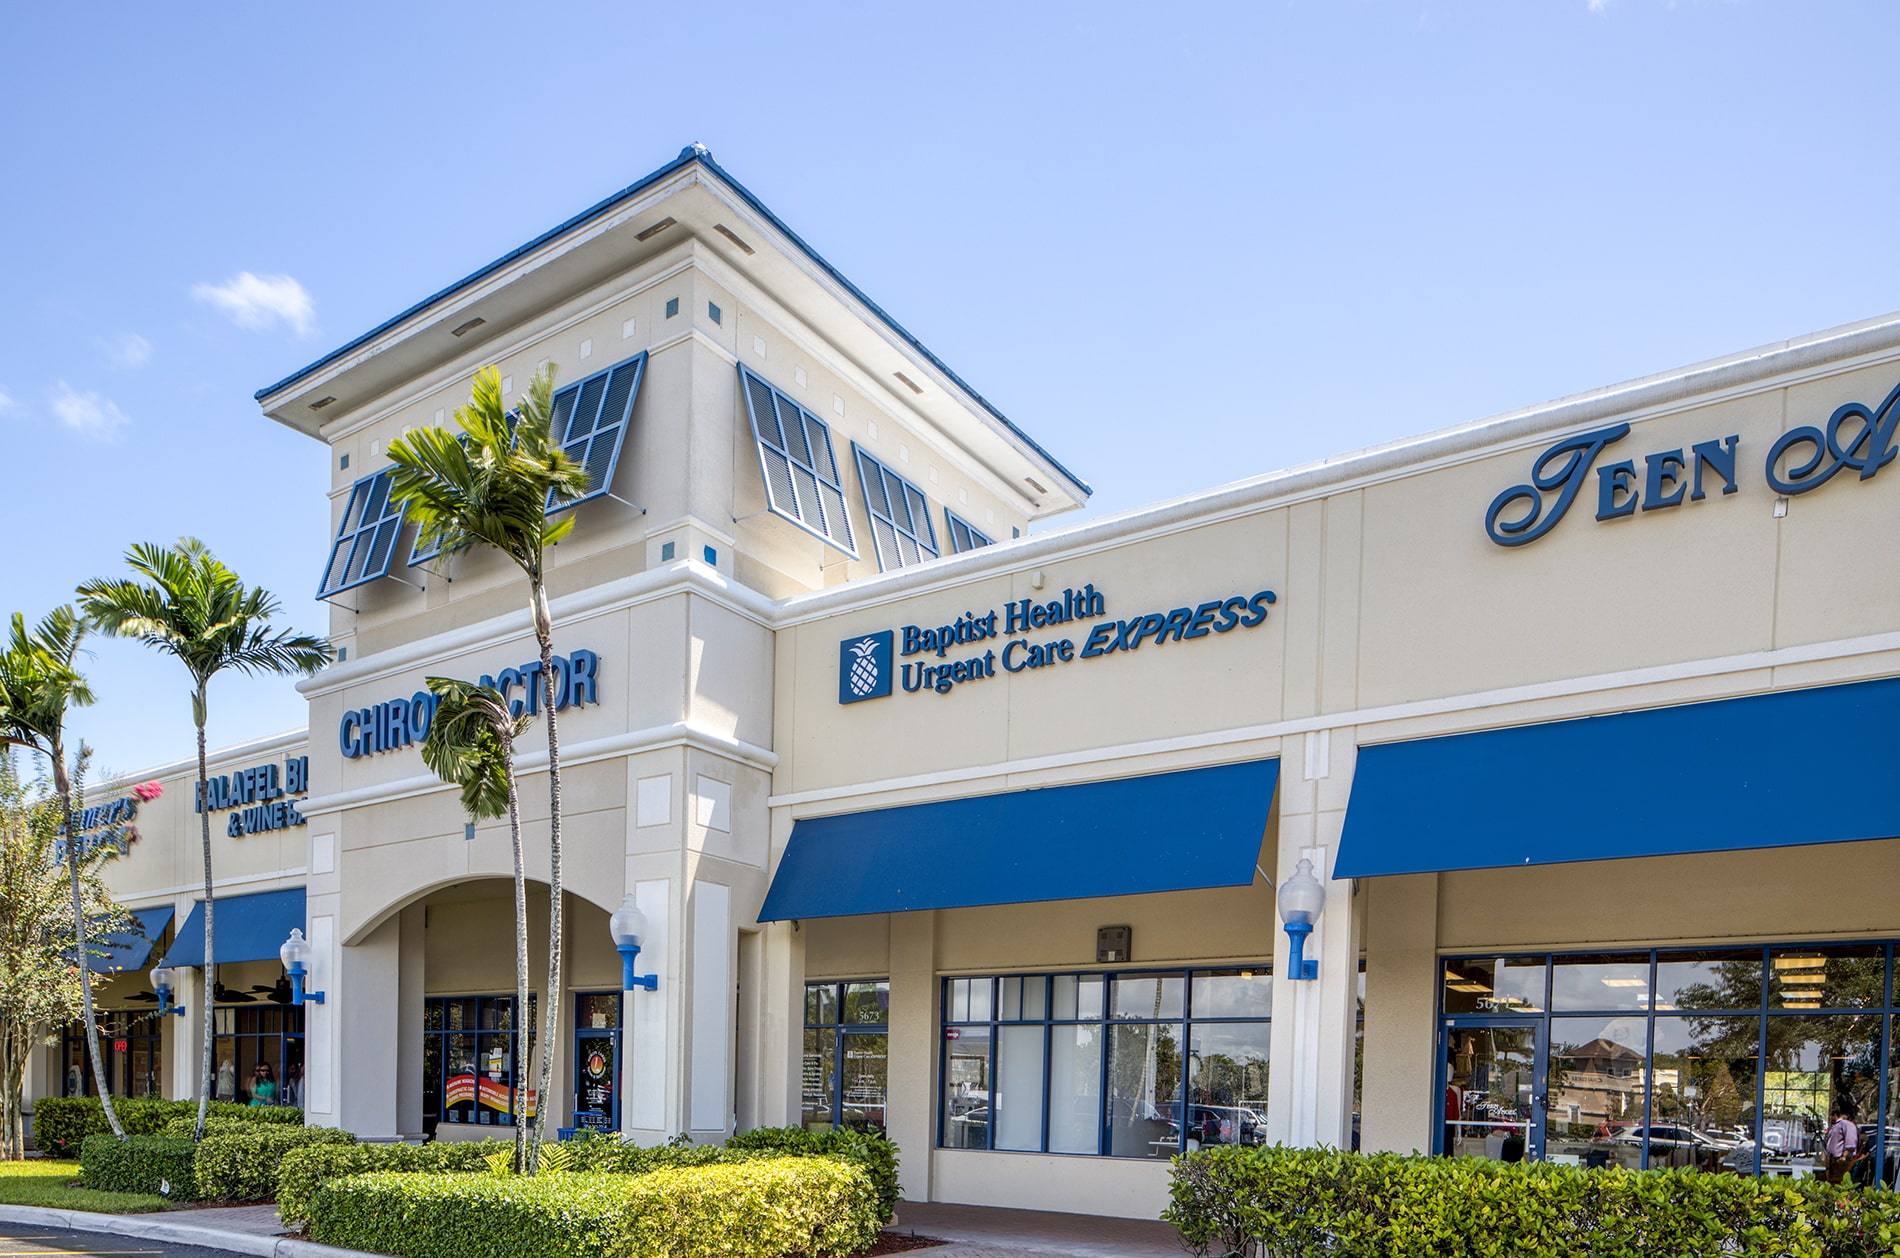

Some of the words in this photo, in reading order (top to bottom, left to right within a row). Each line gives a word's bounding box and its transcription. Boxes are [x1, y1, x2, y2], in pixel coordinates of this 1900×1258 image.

[1485, 423, 1739, 547] TEEN
[900, 608, 998, 657] Baptist
[1004, 584, 1105, 635] Health
[901, 648, 996, 694] Urgent
[1002, 637, 1075, 673] Care
[1080, 590, 1277, 659] EXPRESS
[339, 649, 598, 759] CHIROCTOR
[286, 756, 308, 795] BI
[227, 811, 243, 838] &
[242, 801, 288, 835] WINE
[859, 1011, 880, 1021] 5673
